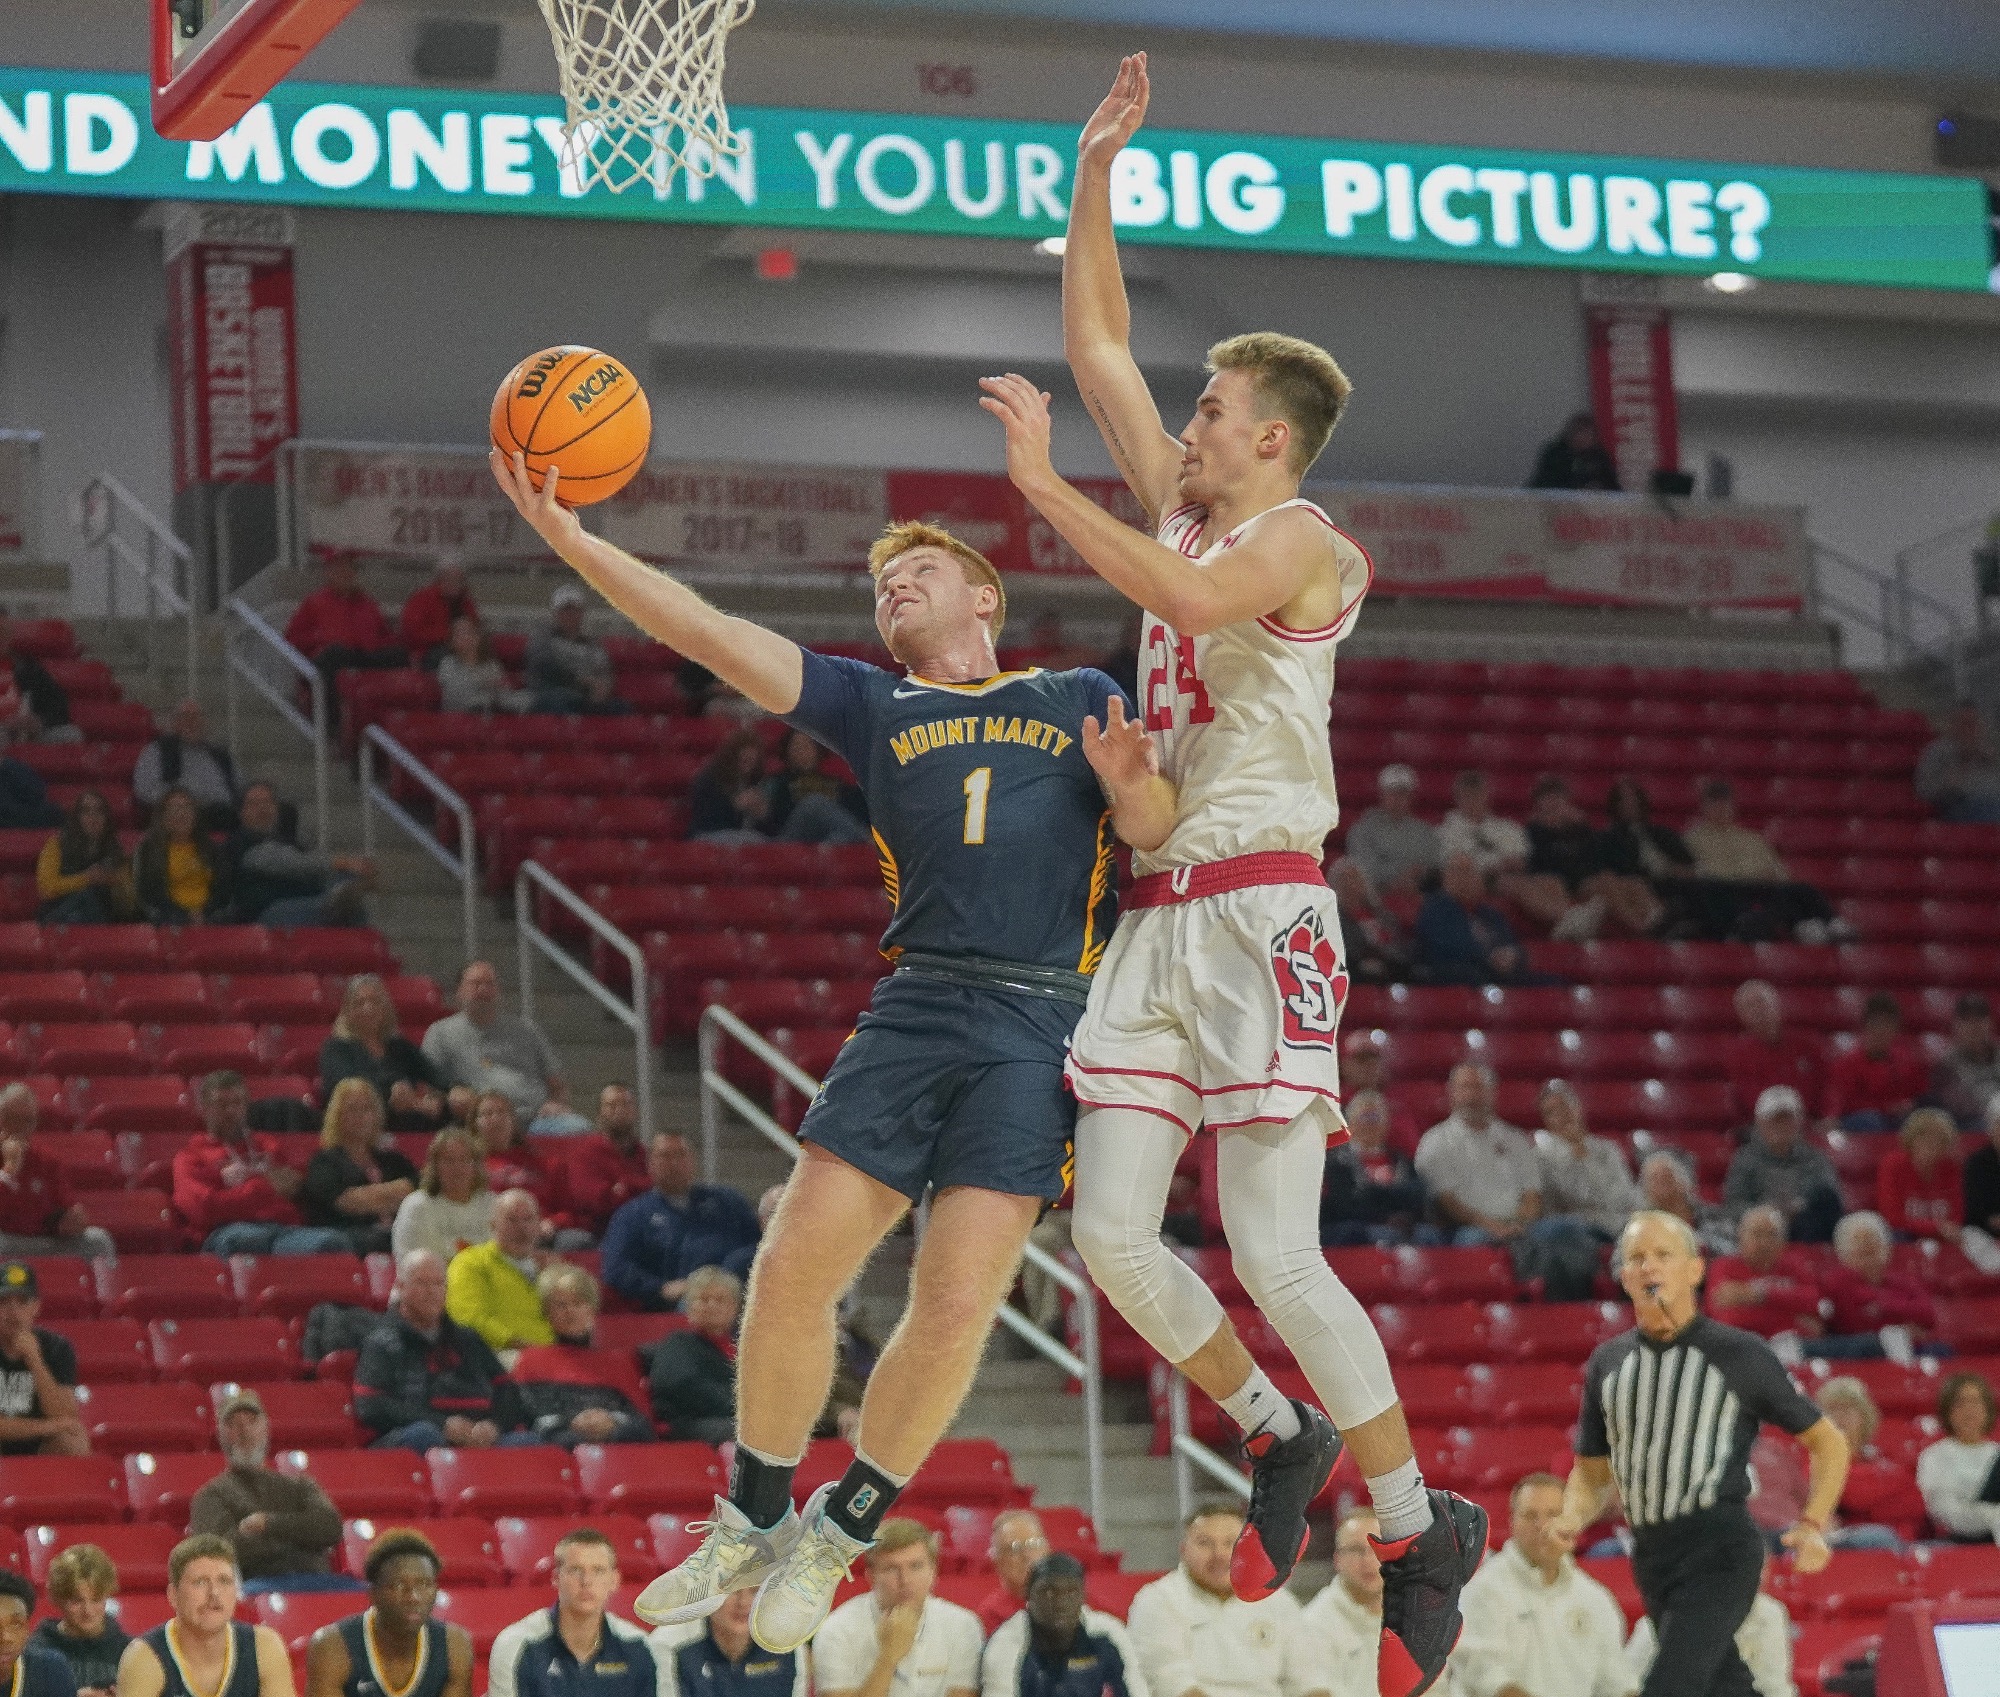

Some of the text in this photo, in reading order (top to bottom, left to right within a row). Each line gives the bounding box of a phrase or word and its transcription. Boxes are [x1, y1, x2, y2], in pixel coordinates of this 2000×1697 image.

[186, 101, 603, 198] MONEY
[651, 122, 757, 206] IN
[794, 130, 1069, 221] YOUR
[1110, 147, 1286, 235] BIG
[1320, 159, 1773, 263] PICTURE?
[204, 264, 254, 478] BASKETBALL
[566, 362, 624, 414] NCAA
[1146, 625, 1215, 731] 24
[889, 716, 1073, 765] MOUNT MARTY
[963, 767, 992, 844] 1
